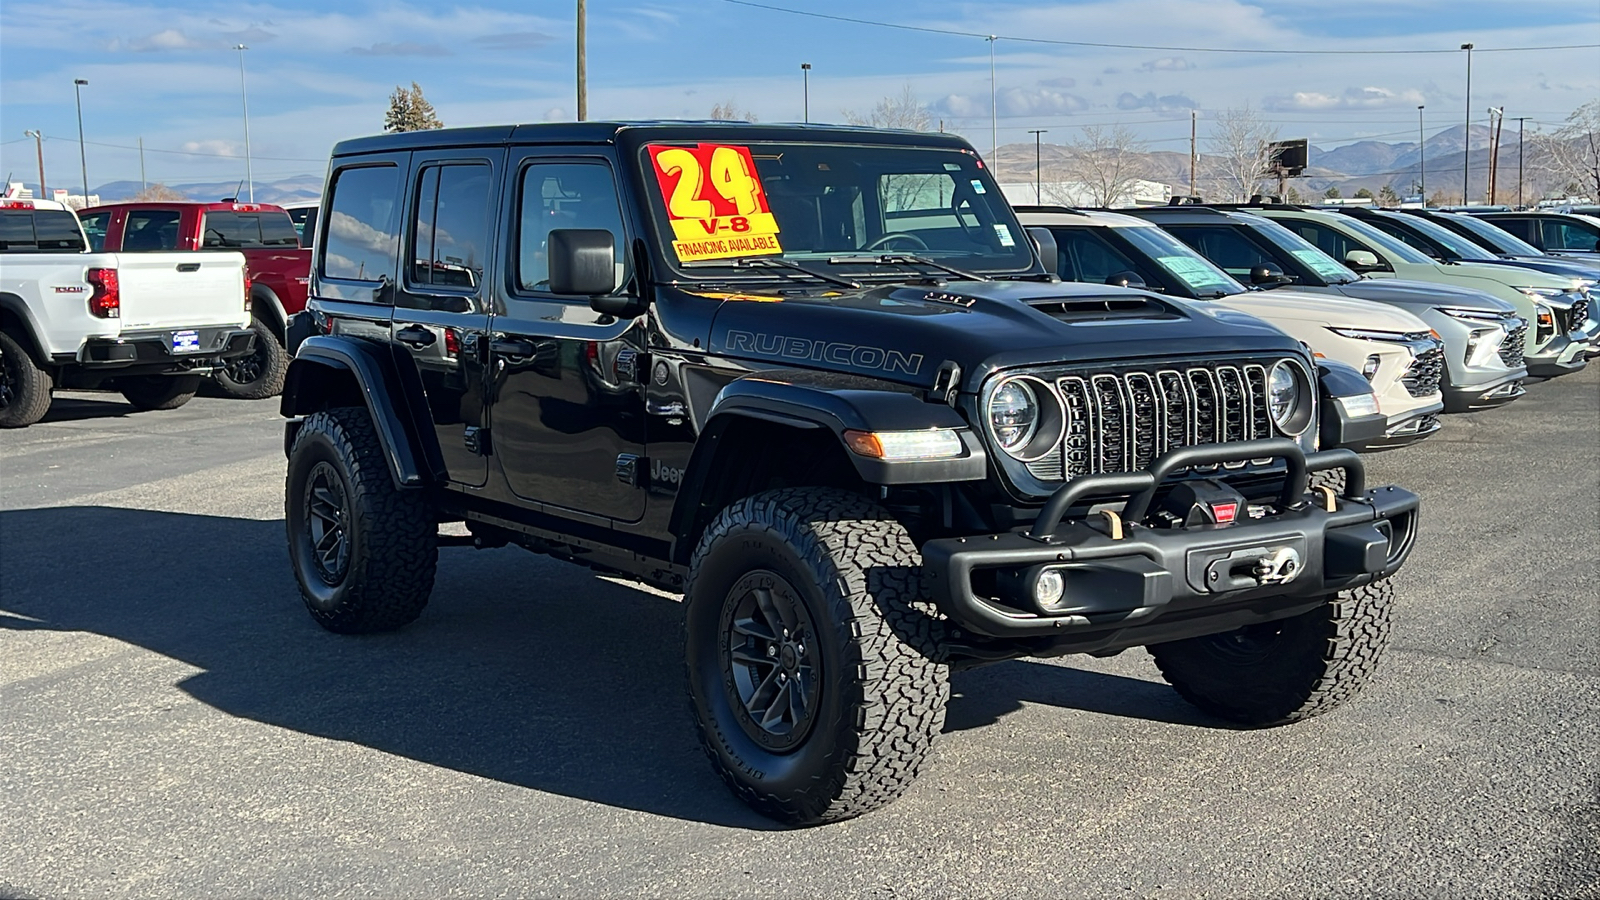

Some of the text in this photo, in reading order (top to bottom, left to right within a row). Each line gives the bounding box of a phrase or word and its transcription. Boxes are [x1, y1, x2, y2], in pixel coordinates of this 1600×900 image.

[656, 147, 761, 218] 24
[699, 217, 751, 235] V-8
[677, 236, 777, 256] FINANCING AVAILABLE
[725, 329, 924, 376] RUBICON
